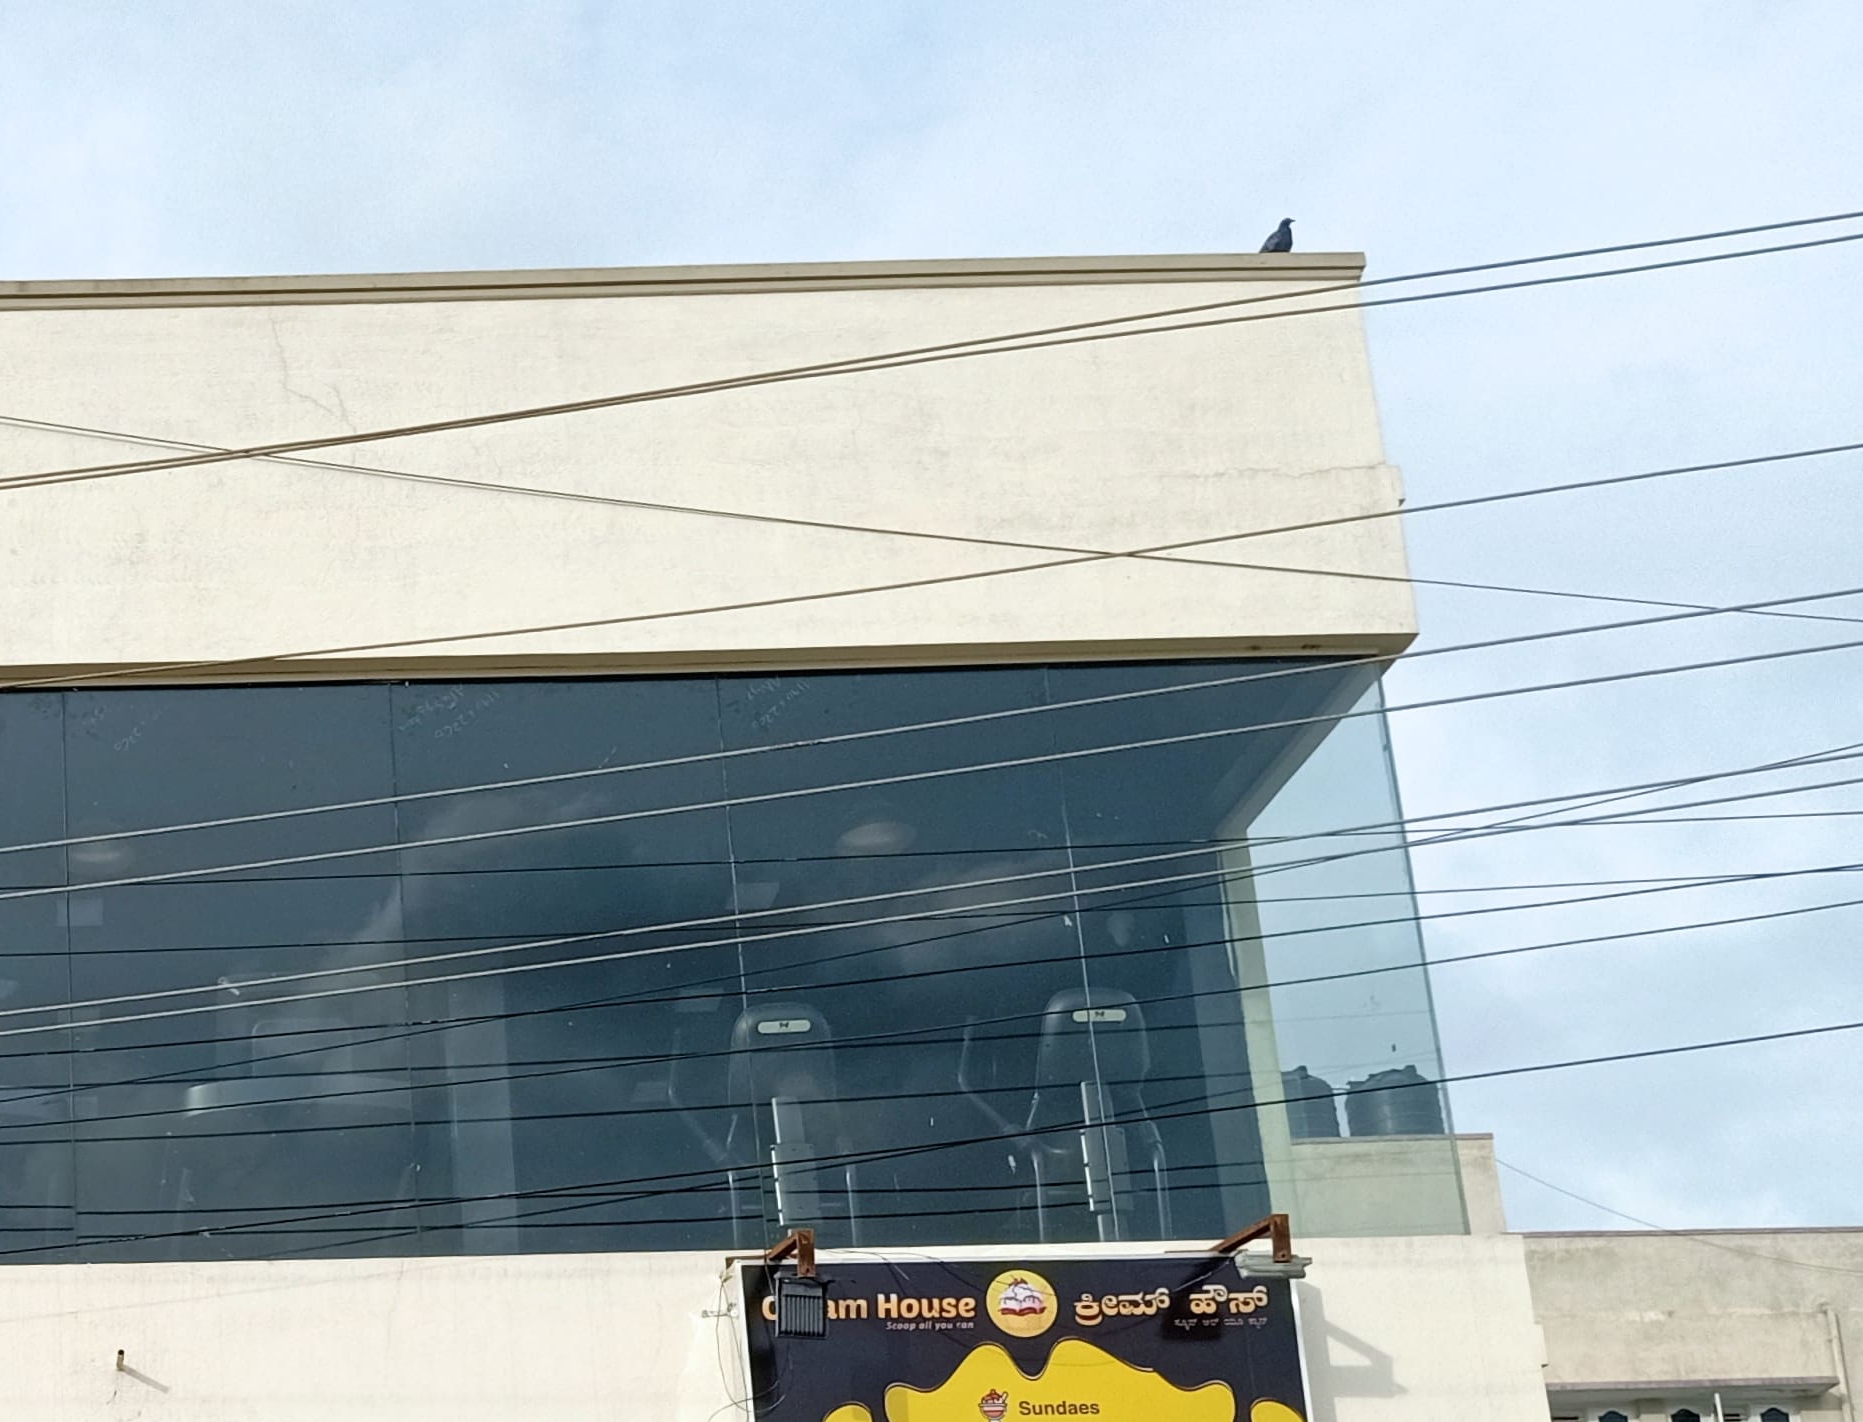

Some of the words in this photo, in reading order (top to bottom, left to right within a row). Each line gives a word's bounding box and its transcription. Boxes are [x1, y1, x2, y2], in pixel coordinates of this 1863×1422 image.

[761, 1295, 869, 1321] Cam
[877, 1293, 976, 1320] House
[1074, 1287, 1171, 1326] ಕ್ರೀಮ್
[1189, 1284, 1269, 1315] ಹೌಸ್
[886, 1321, 916, 1331] Scoop
[919, 1320, 932, 1330] all
[935, 1321, 953, 1331] you
[956, 1321, 974, 1329] can
[1018, 1400, 1100, 1416] Sundaes
